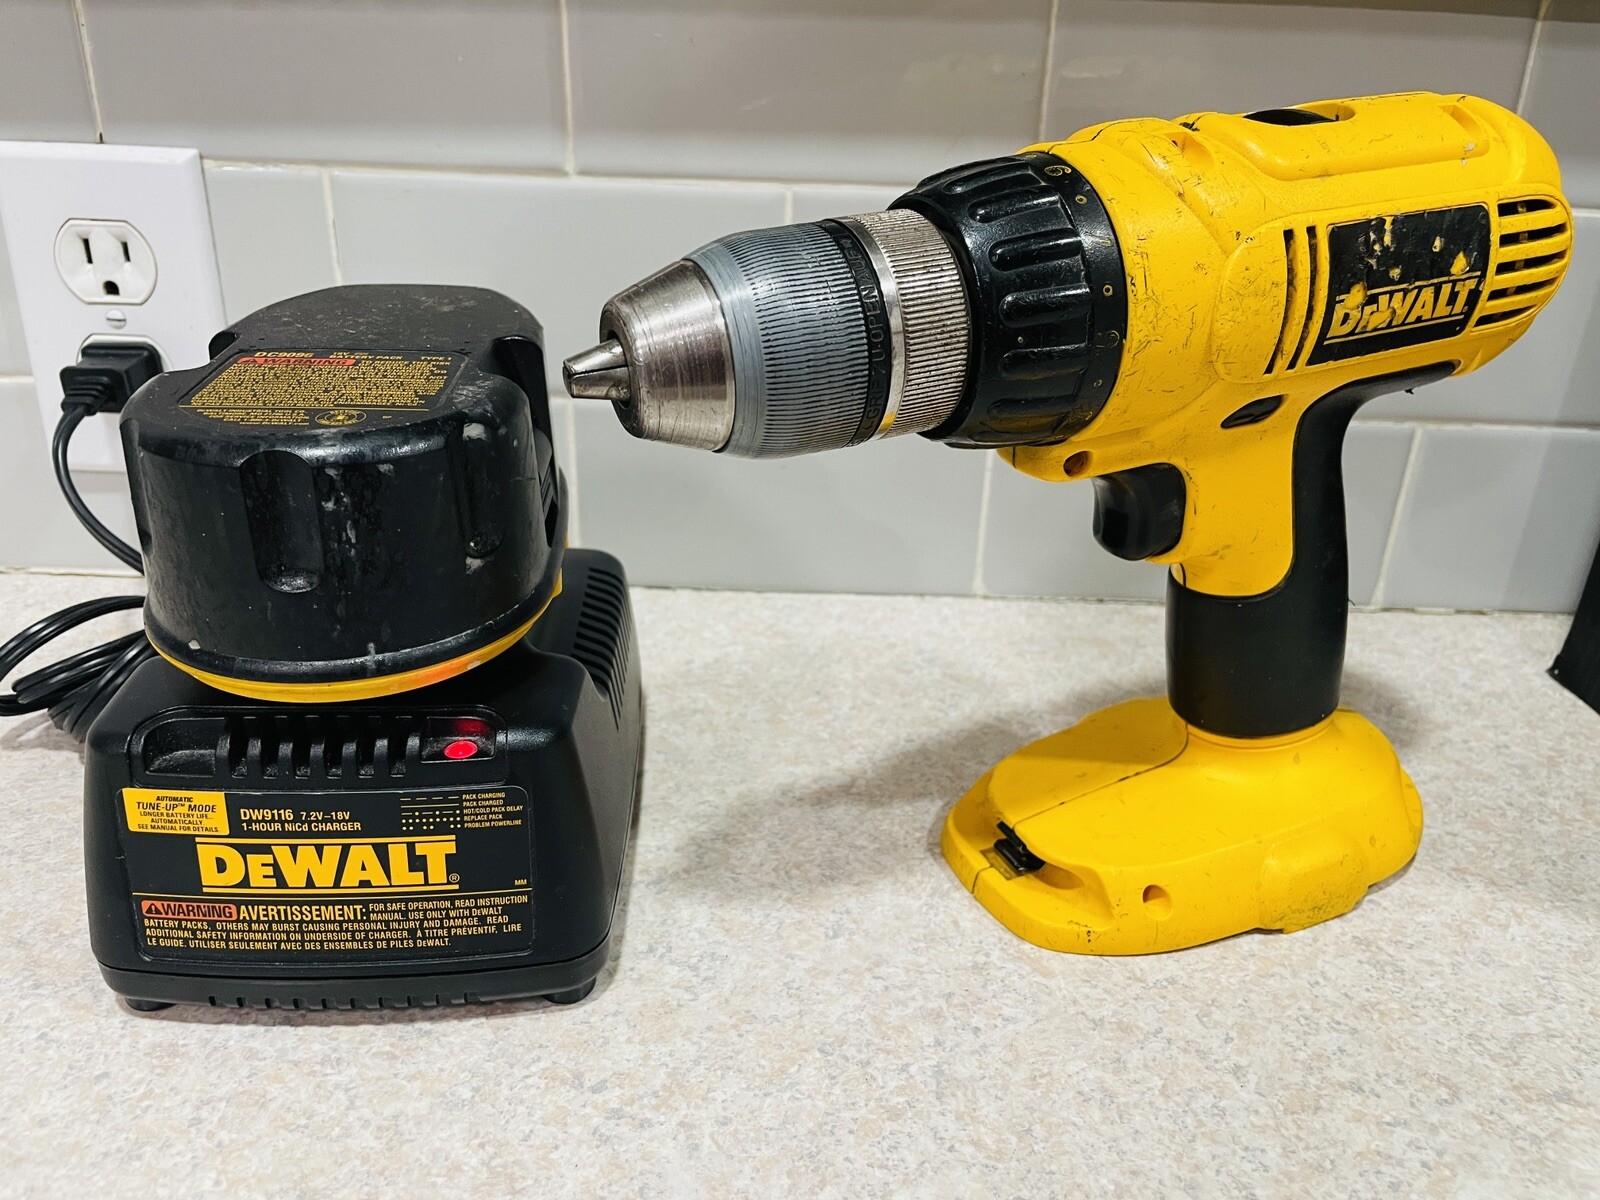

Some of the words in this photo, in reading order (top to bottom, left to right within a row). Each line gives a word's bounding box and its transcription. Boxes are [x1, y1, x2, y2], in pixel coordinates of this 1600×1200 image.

[156, 795, 193, 803] AUTOMATIC
[477, 791, 506, 799] CHARGING
[188, 804, 217, 813] MODE
[478, 799, 504, 807] CHARGED
[240, 808, 294, 821] DW9116
[241, 822, 282, 832] 1-HOUR
[285, 822, 309, 832] NiCd
[311, 822, 362, 832] CHARGER
[464, 821, 490, 829] PROBLEM
[491, 819, 522, 827] POWERLINE
[161, 902, 233, 918] WARNING
[239, 905, 366, 921] AVERTISSEMENT:
[369, 903, 380, 912] FOR
[386, 902, 406, 911] SAFE
[455, 898, 476, 908] READ
[477, 895, 528, 907] INSTRUCTION
[408, 911, 425, 920] USE
[426, 910, 447, 919] ONLY
[449, 908, 470, 918] WITH
[144, 918, 179, 929] BATTERY
[216, 922, 249, 931] OTHERS
[251, 922, 270, 932] MAY
[272, 923, 299, 932] BURST
[302, 923, 340, 932] CAUSING
[342, 921, 388, 931] PERSONAL
[389, 919, 420, 930] INJURY
[423, 918, 441, 928] AND
[486, 915, 509, 925] READ
[145, 928, 194, 939] ADDITIONAL
[196, 930, 227, 940] SAFETY
[229, 932, 287, 941] INFORMATION
[289, 932, 301, 941] ON
[304, 931, 353, 941] UNDERSIDE
[354, 931, 366, 940] OF
[424, 928, 449, 938] TITRE
[503, 923, 522, 933] LIRE
[147, 937, 157, 946] LE
[189, 939, 226, 949] UTILISER
[228, 941, 277, 950] SEULEMENT
[280, 941, 302, 951] AVEC
[304, 941, 321, 950] DES
[323, 940, 374, 950] ENSEMBLES
[376, 940, 388, 949] DE
[390, 938, 414, 948] PILES
